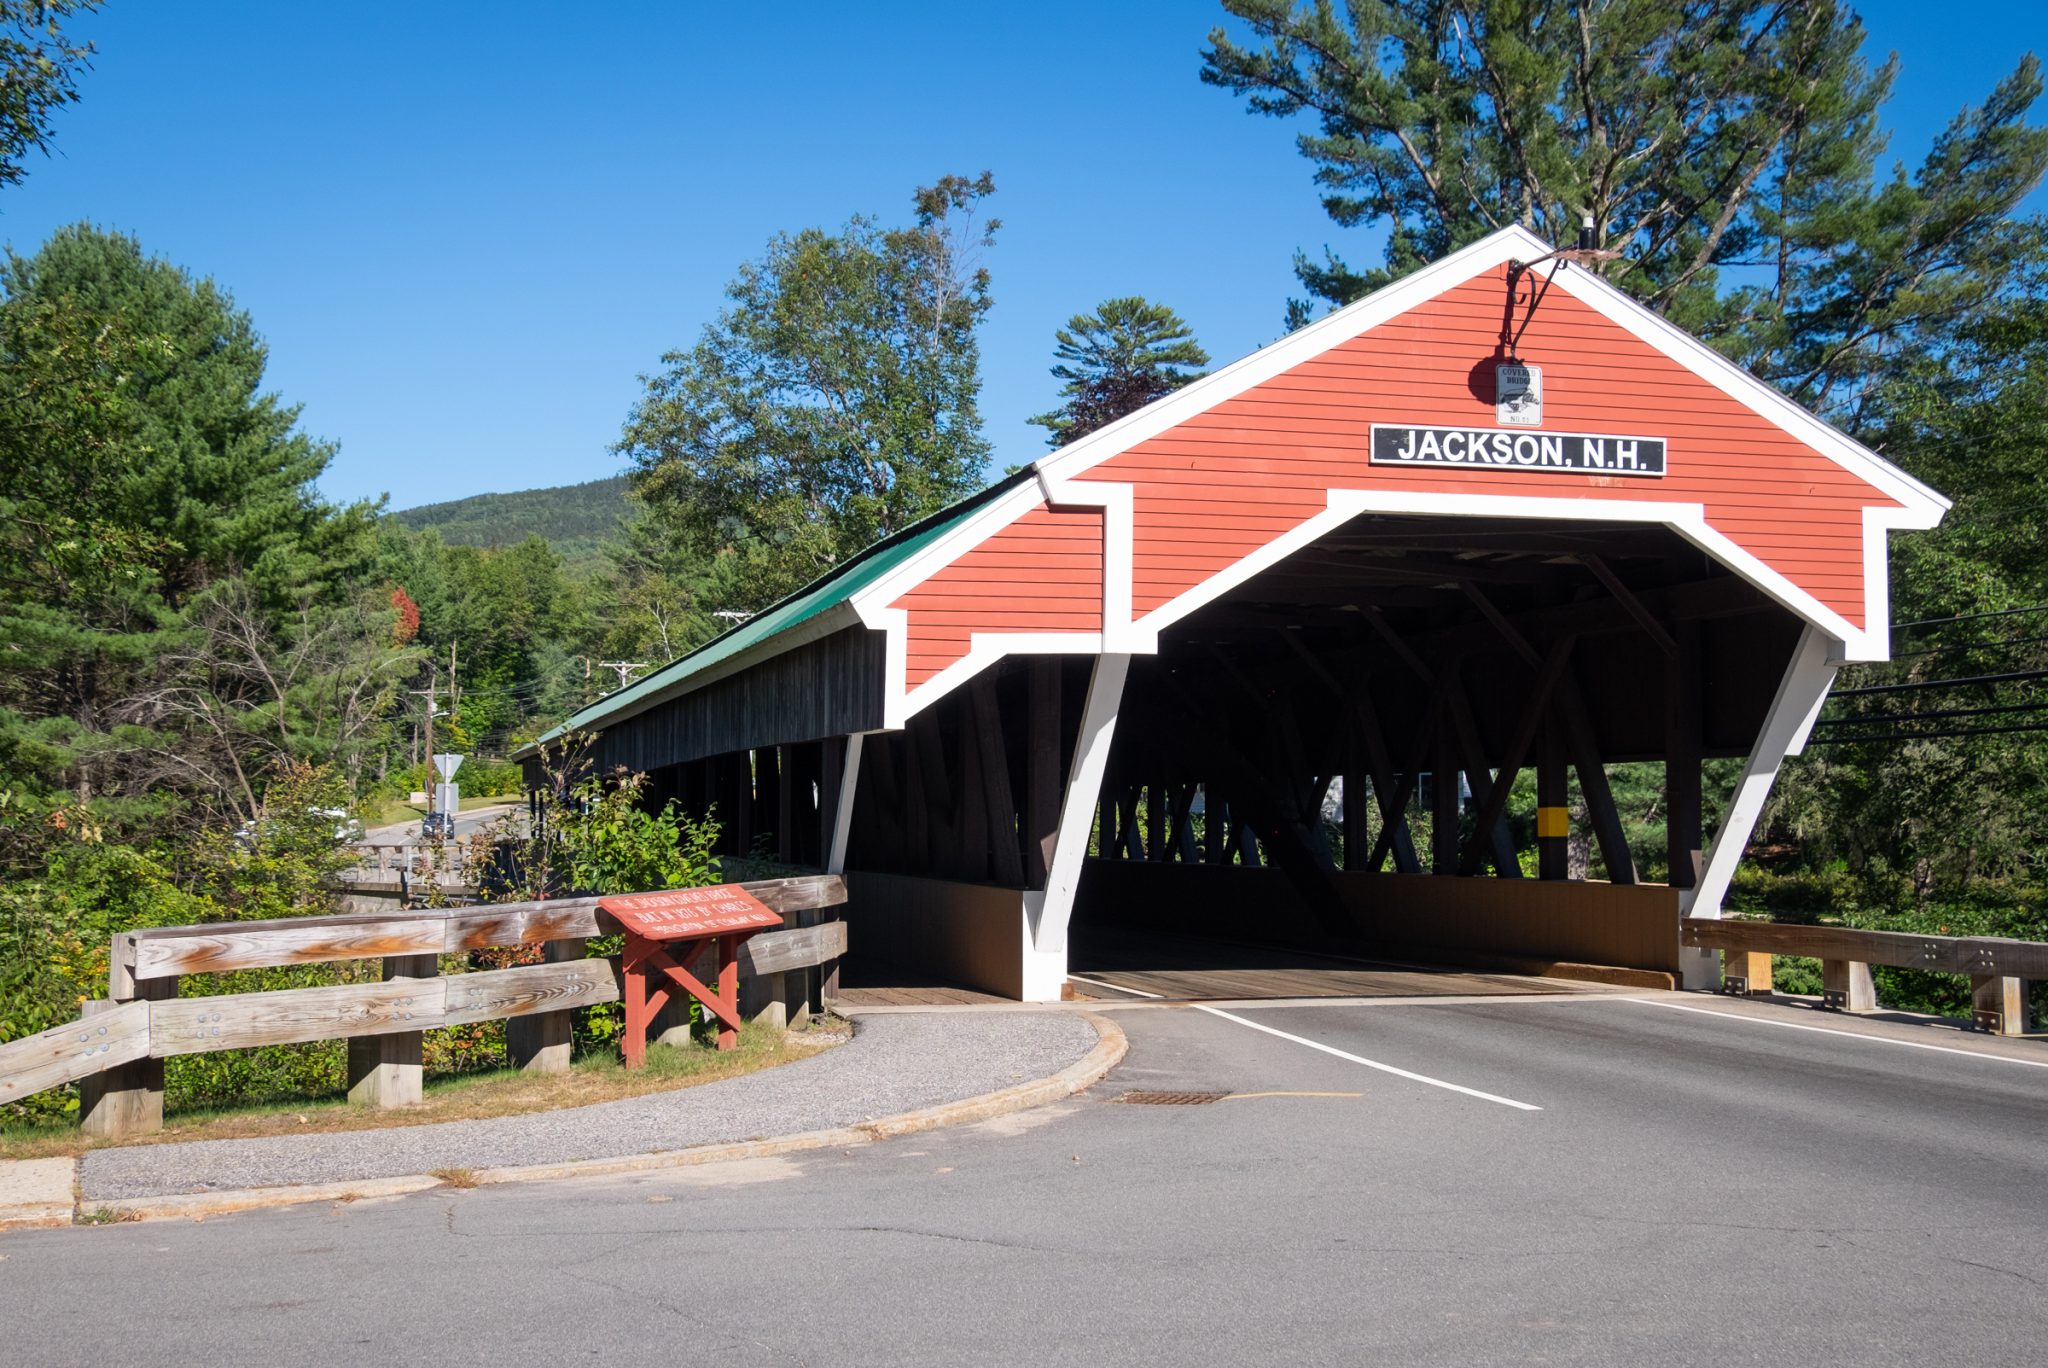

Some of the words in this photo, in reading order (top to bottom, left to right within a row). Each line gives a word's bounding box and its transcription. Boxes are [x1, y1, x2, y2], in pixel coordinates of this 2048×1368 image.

[1507, 376, 1532, 384] BRIDG
[1398, 430, 1573, 468] JACKSON,
[1583, 438, 1648, 470] N.H.
[633, 911, 664, 924] BUILT
[711, 900, 753, 914] CHARLES
